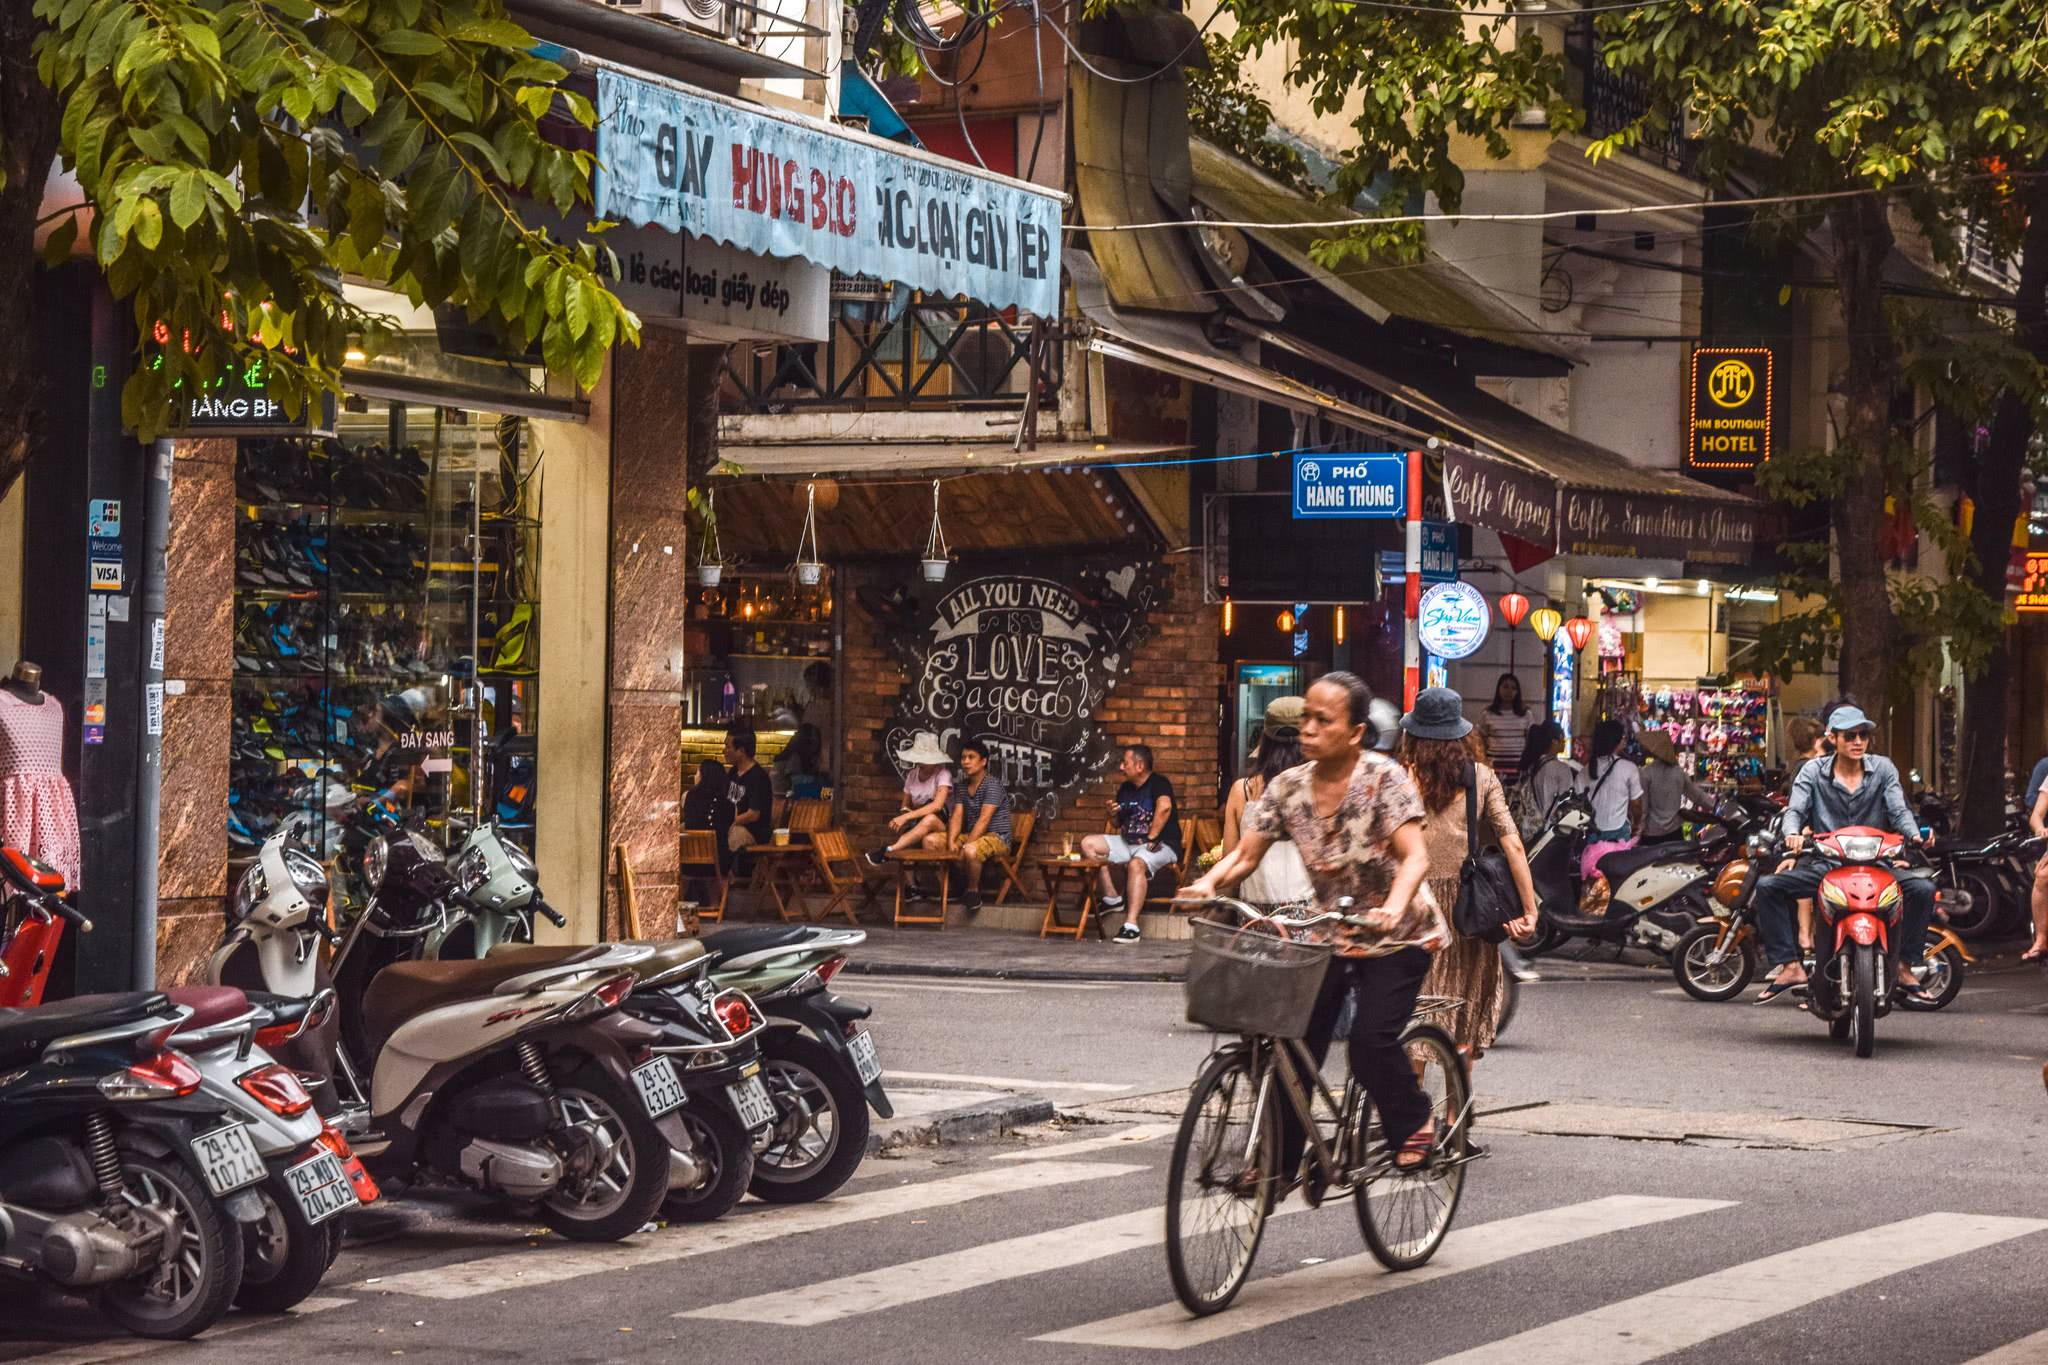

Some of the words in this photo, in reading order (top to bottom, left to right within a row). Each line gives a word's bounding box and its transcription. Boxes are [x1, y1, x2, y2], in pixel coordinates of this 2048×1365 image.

[650, 259, 681, 291] các
[686, 266, 717, 305] loại
[760, 279, 790, 317] dép
[1702, 436, 1758, 452] HOTEL
[1332, 460, 1368, 479] PHỐ
[1306, 481, 1345, 507] HÀNG
[1349, 480, 1395, 507] THÙNG
[92, 541, 122, 552] Welcome
[97, 567, 119, 580] VISA
[949, 588, 980, 623] ALL
[980, 583, 1021, 608] YOU
[1029, 583, 1080, 622] NEED
[1007, 612, 1020, 634] IS
[966, 633, 1060, 685] LOVE
[966, 688, 985, 709] a
[987, 675, 1073, 728] good
[425, 731, 455, 748] SANG
[1000, 713, 1026, 737] CUP
[1031, 720, 1048, 742] OF
[638, 1061, 672, 1092] 29-C1
[647, 1079, 685, 1114] 432.32
[740, 1099, 775, 1129] 107.45
[201, 1129, 247, 1164] 29-C1
[303, 1180, 352, 1219] 204.05
